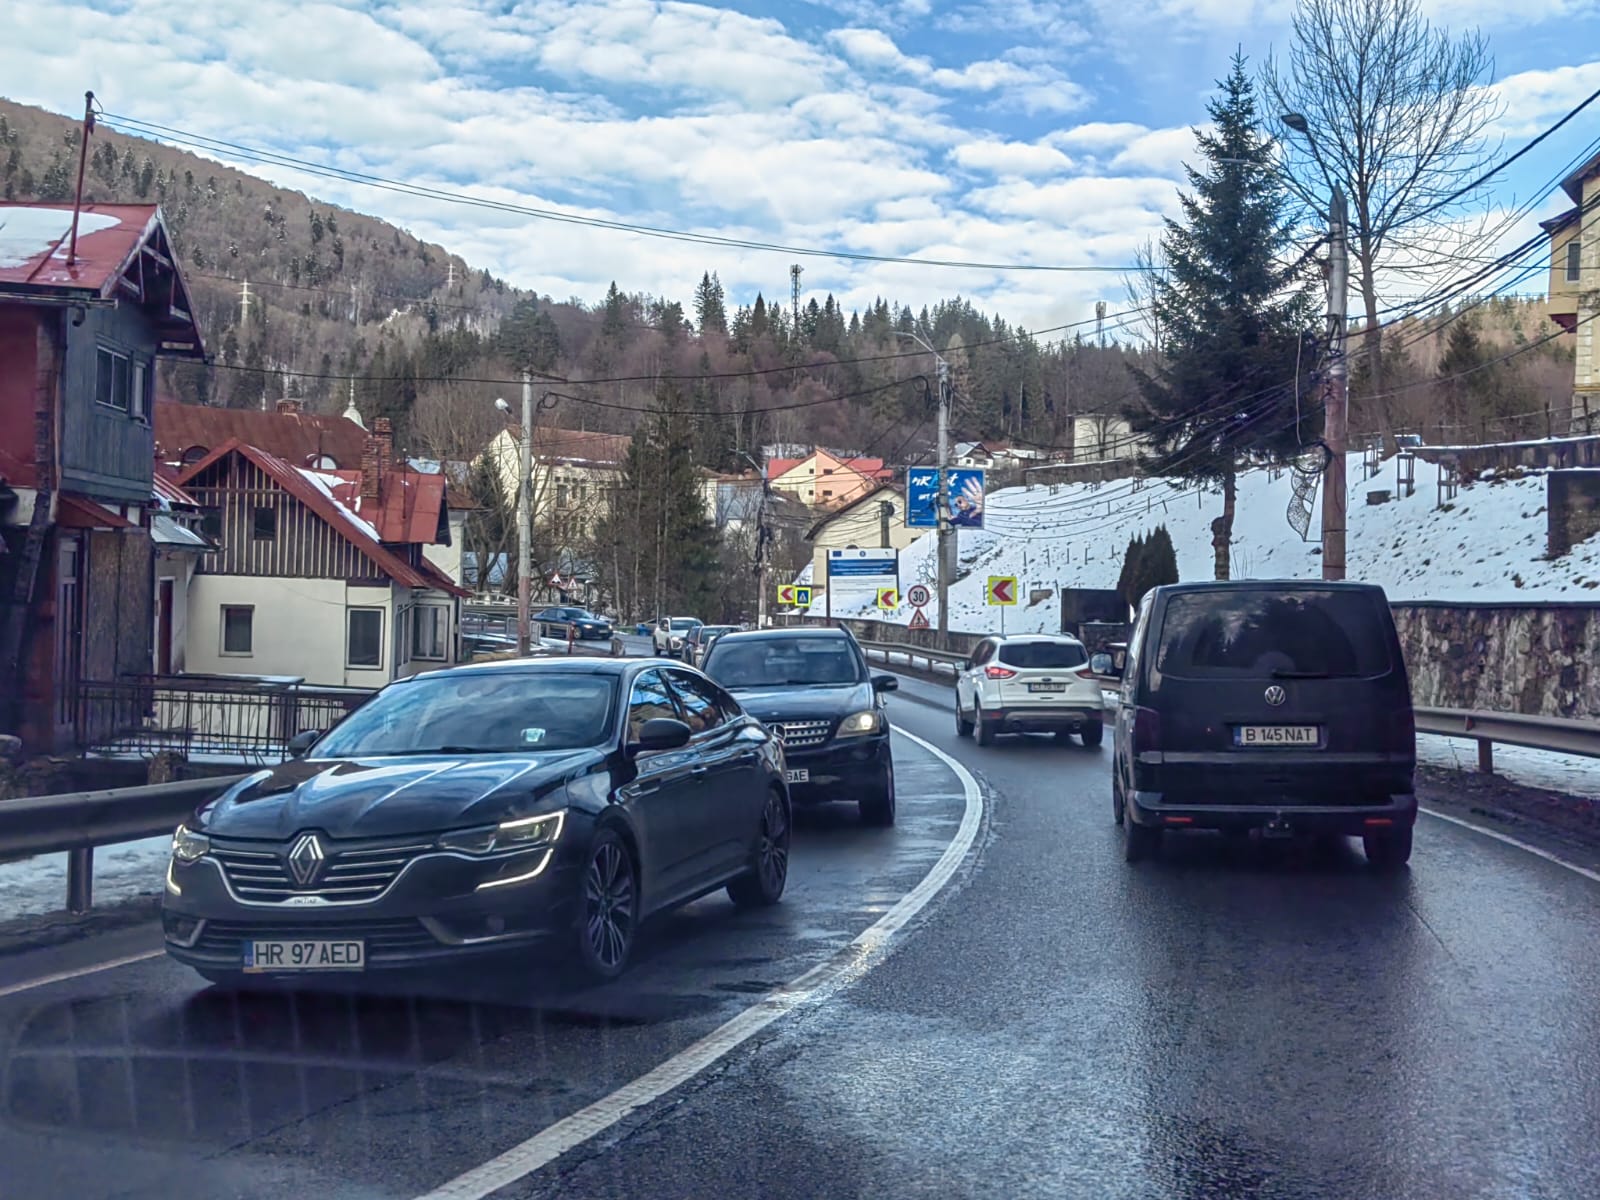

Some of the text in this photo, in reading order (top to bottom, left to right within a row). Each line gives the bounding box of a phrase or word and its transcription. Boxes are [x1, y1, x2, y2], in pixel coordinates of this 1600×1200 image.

[913, 591, 925, 603] 30
[1245, 728, 1256, 741] B
[1261, 728, 1283, 741] 145
[1285, 728, 1313, 741] NAT
[255, 943, 284, 965] HR
[292, 943, 316, 965] 97
[319, 942, 361, 965] AED
